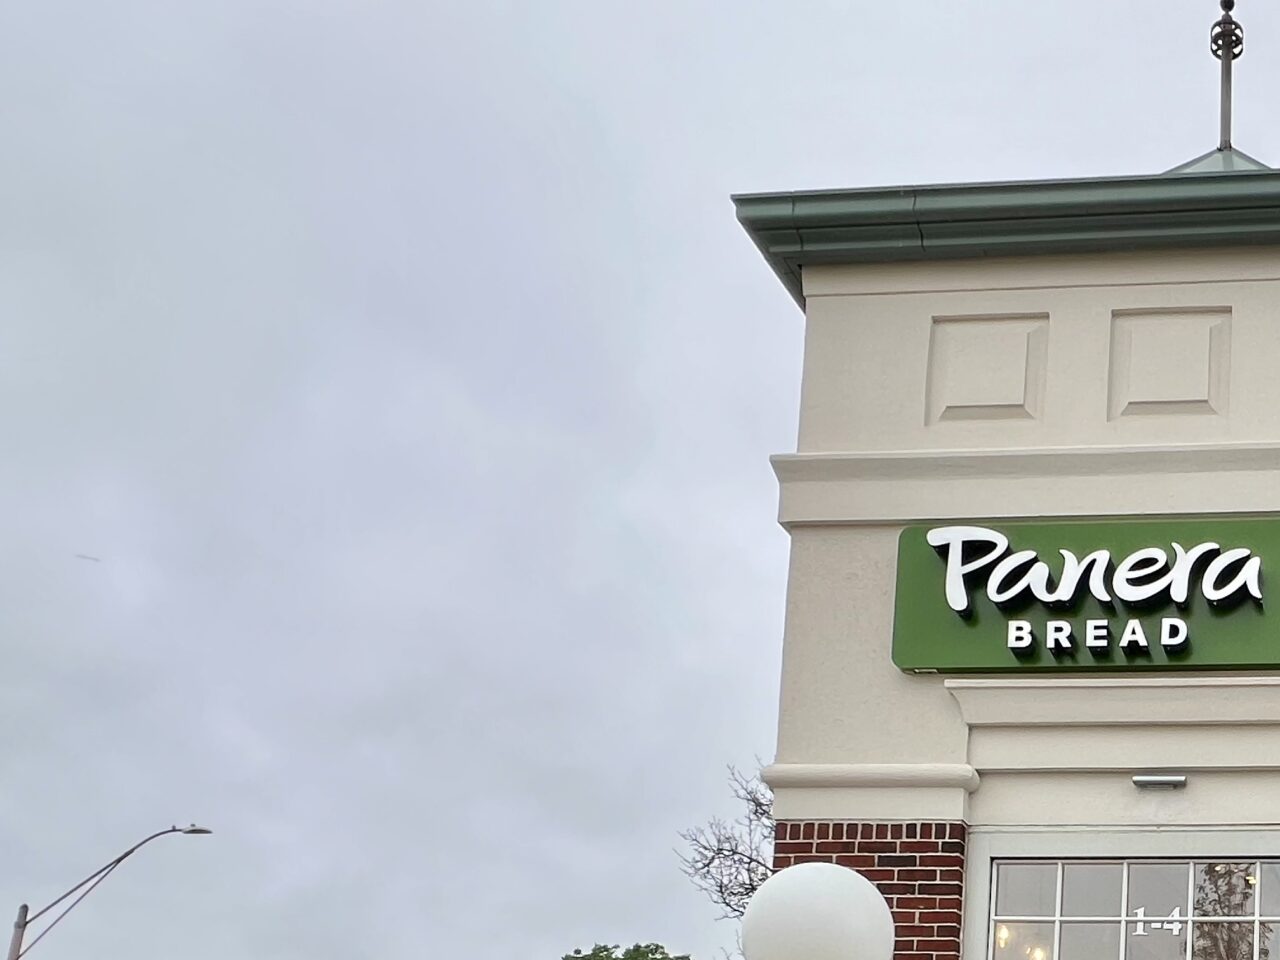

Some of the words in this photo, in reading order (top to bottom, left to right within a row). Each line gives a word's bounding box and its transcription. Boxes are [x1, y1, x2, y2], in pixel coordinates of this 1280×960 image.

[926, 525, 1264, 612] Panera
[1007, 618, 1189, 649] BREAD
[1132, 906, 1182, 936] 1-4
